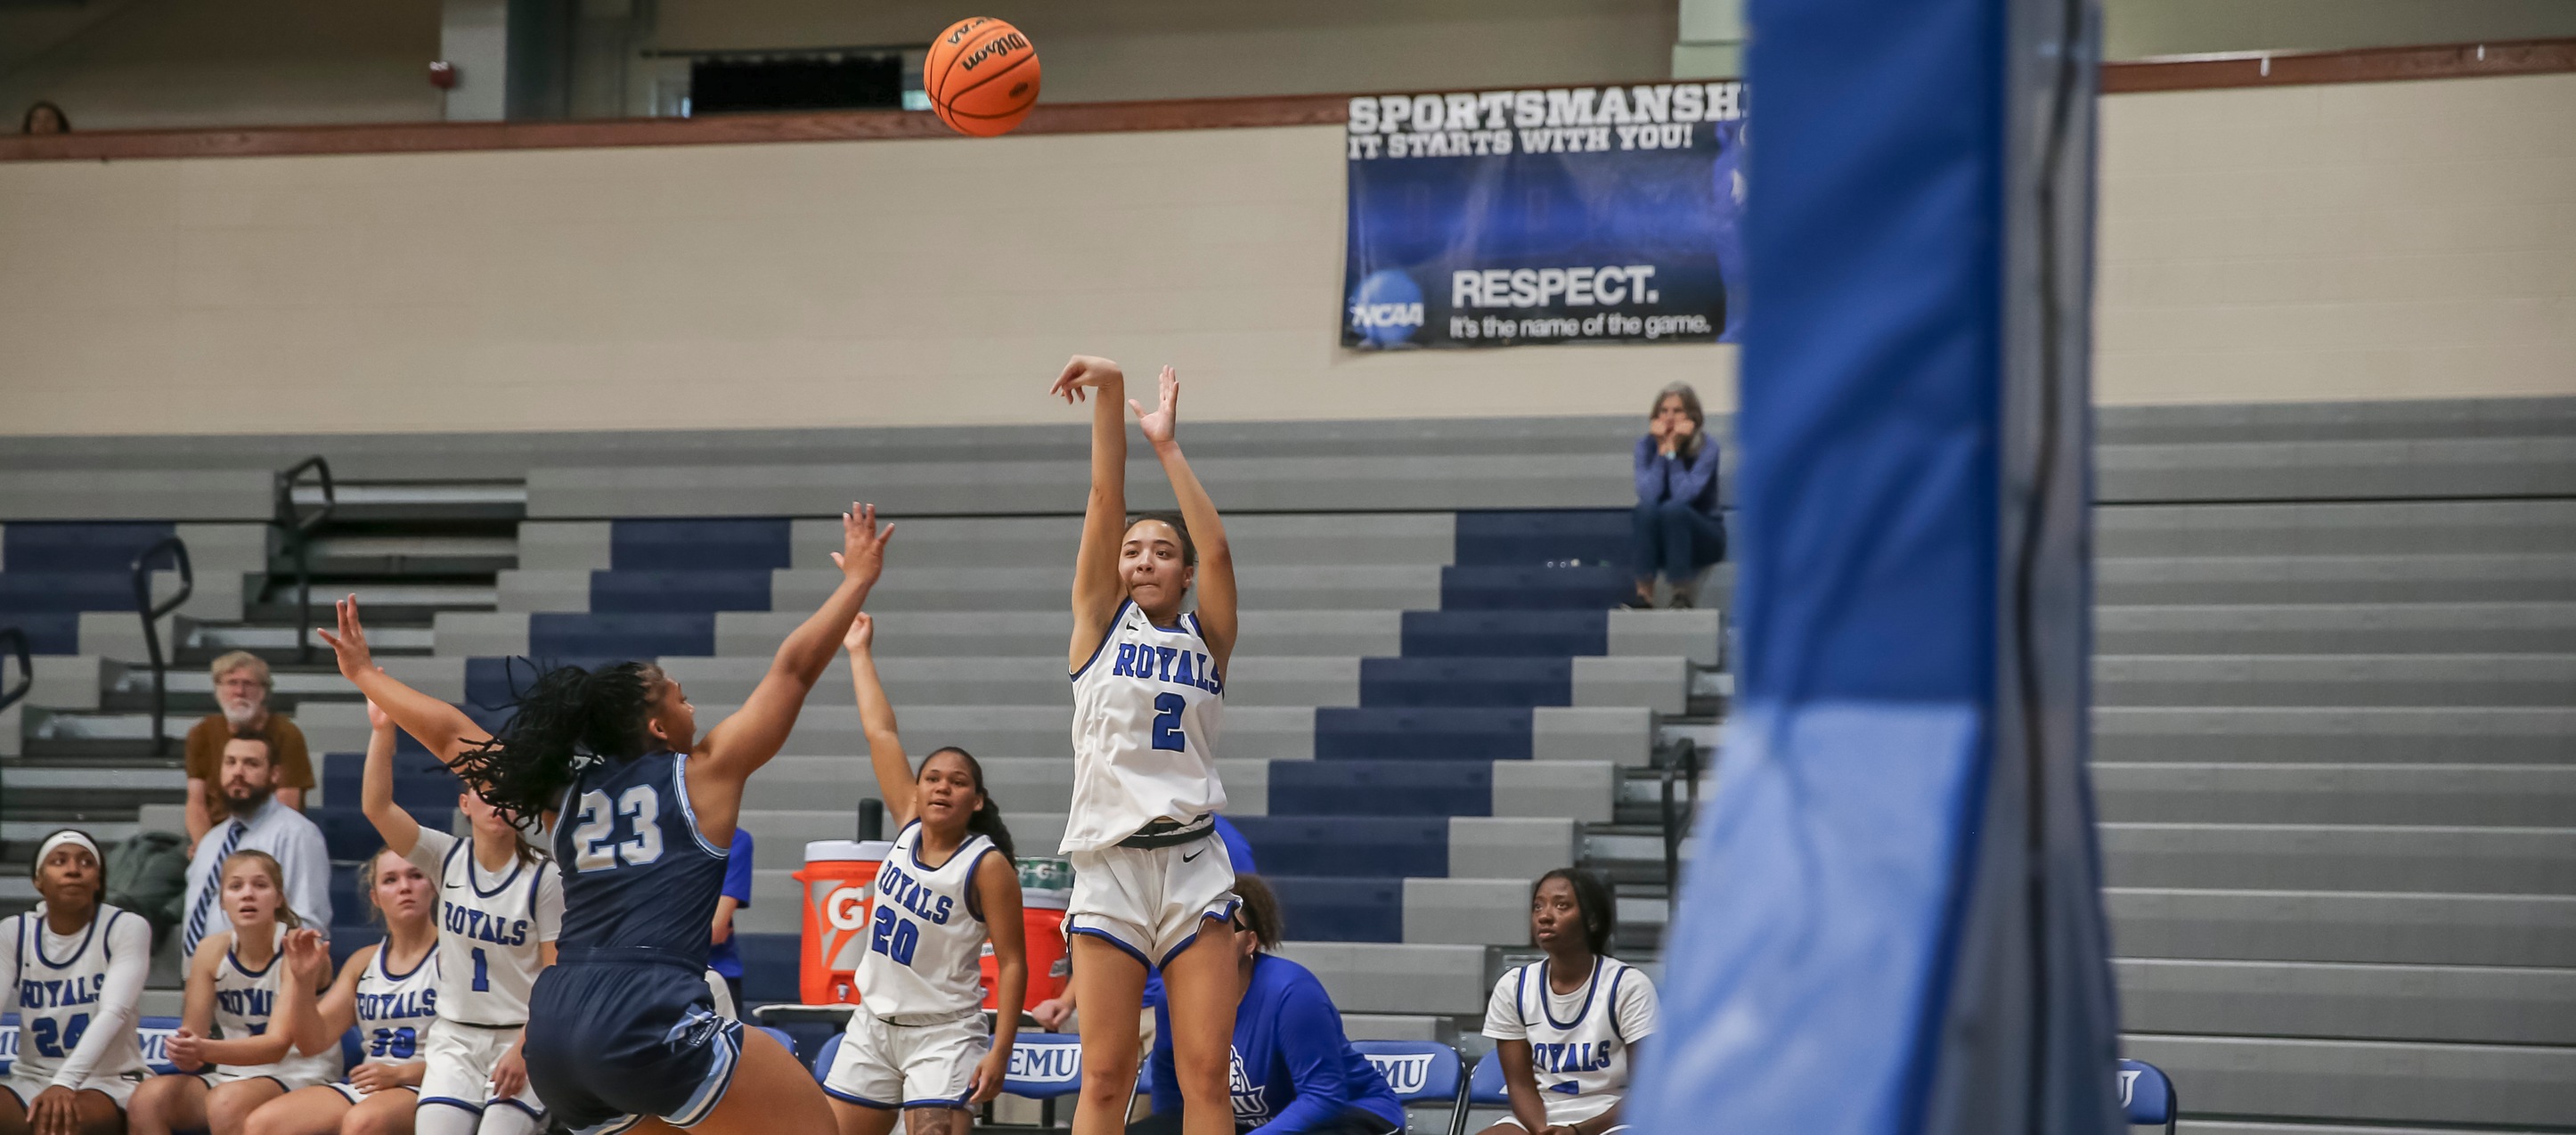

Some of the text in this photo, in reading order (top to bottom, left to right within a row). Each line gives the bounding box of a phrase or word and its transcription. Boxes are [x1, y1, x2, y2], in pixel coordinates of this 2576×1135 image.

[962, 32, 1028, 71] Wilson
[1349, 123, 1693, 160] IT STARTS WITH YOU!
[1452, 265, 1660, 309] RESPECT.
[1351, 302, 1425, 328] NCAA
[1450, 312, 1712, 339] It's the name of the game.
[1113, 643, 1222, 695] ROYALS
[1152, 691, 1186, 753] 2
[571, 783, 664, 873] 23
[827, 886, 865, 931] G
[879, 860, 953, 926] ROYALS
[444, 901, 527, 946] ROYALS
[871, 904, 919, 968] 20
[471, 946, 489, 992] 1
[356, 988, 436, 1020] ROYALS
[1009, 1048, 1078, 1076] EMU
[1376, 1059, 1425, 1088] MU
[1533, 1040, 1611, 1074] OYALS
